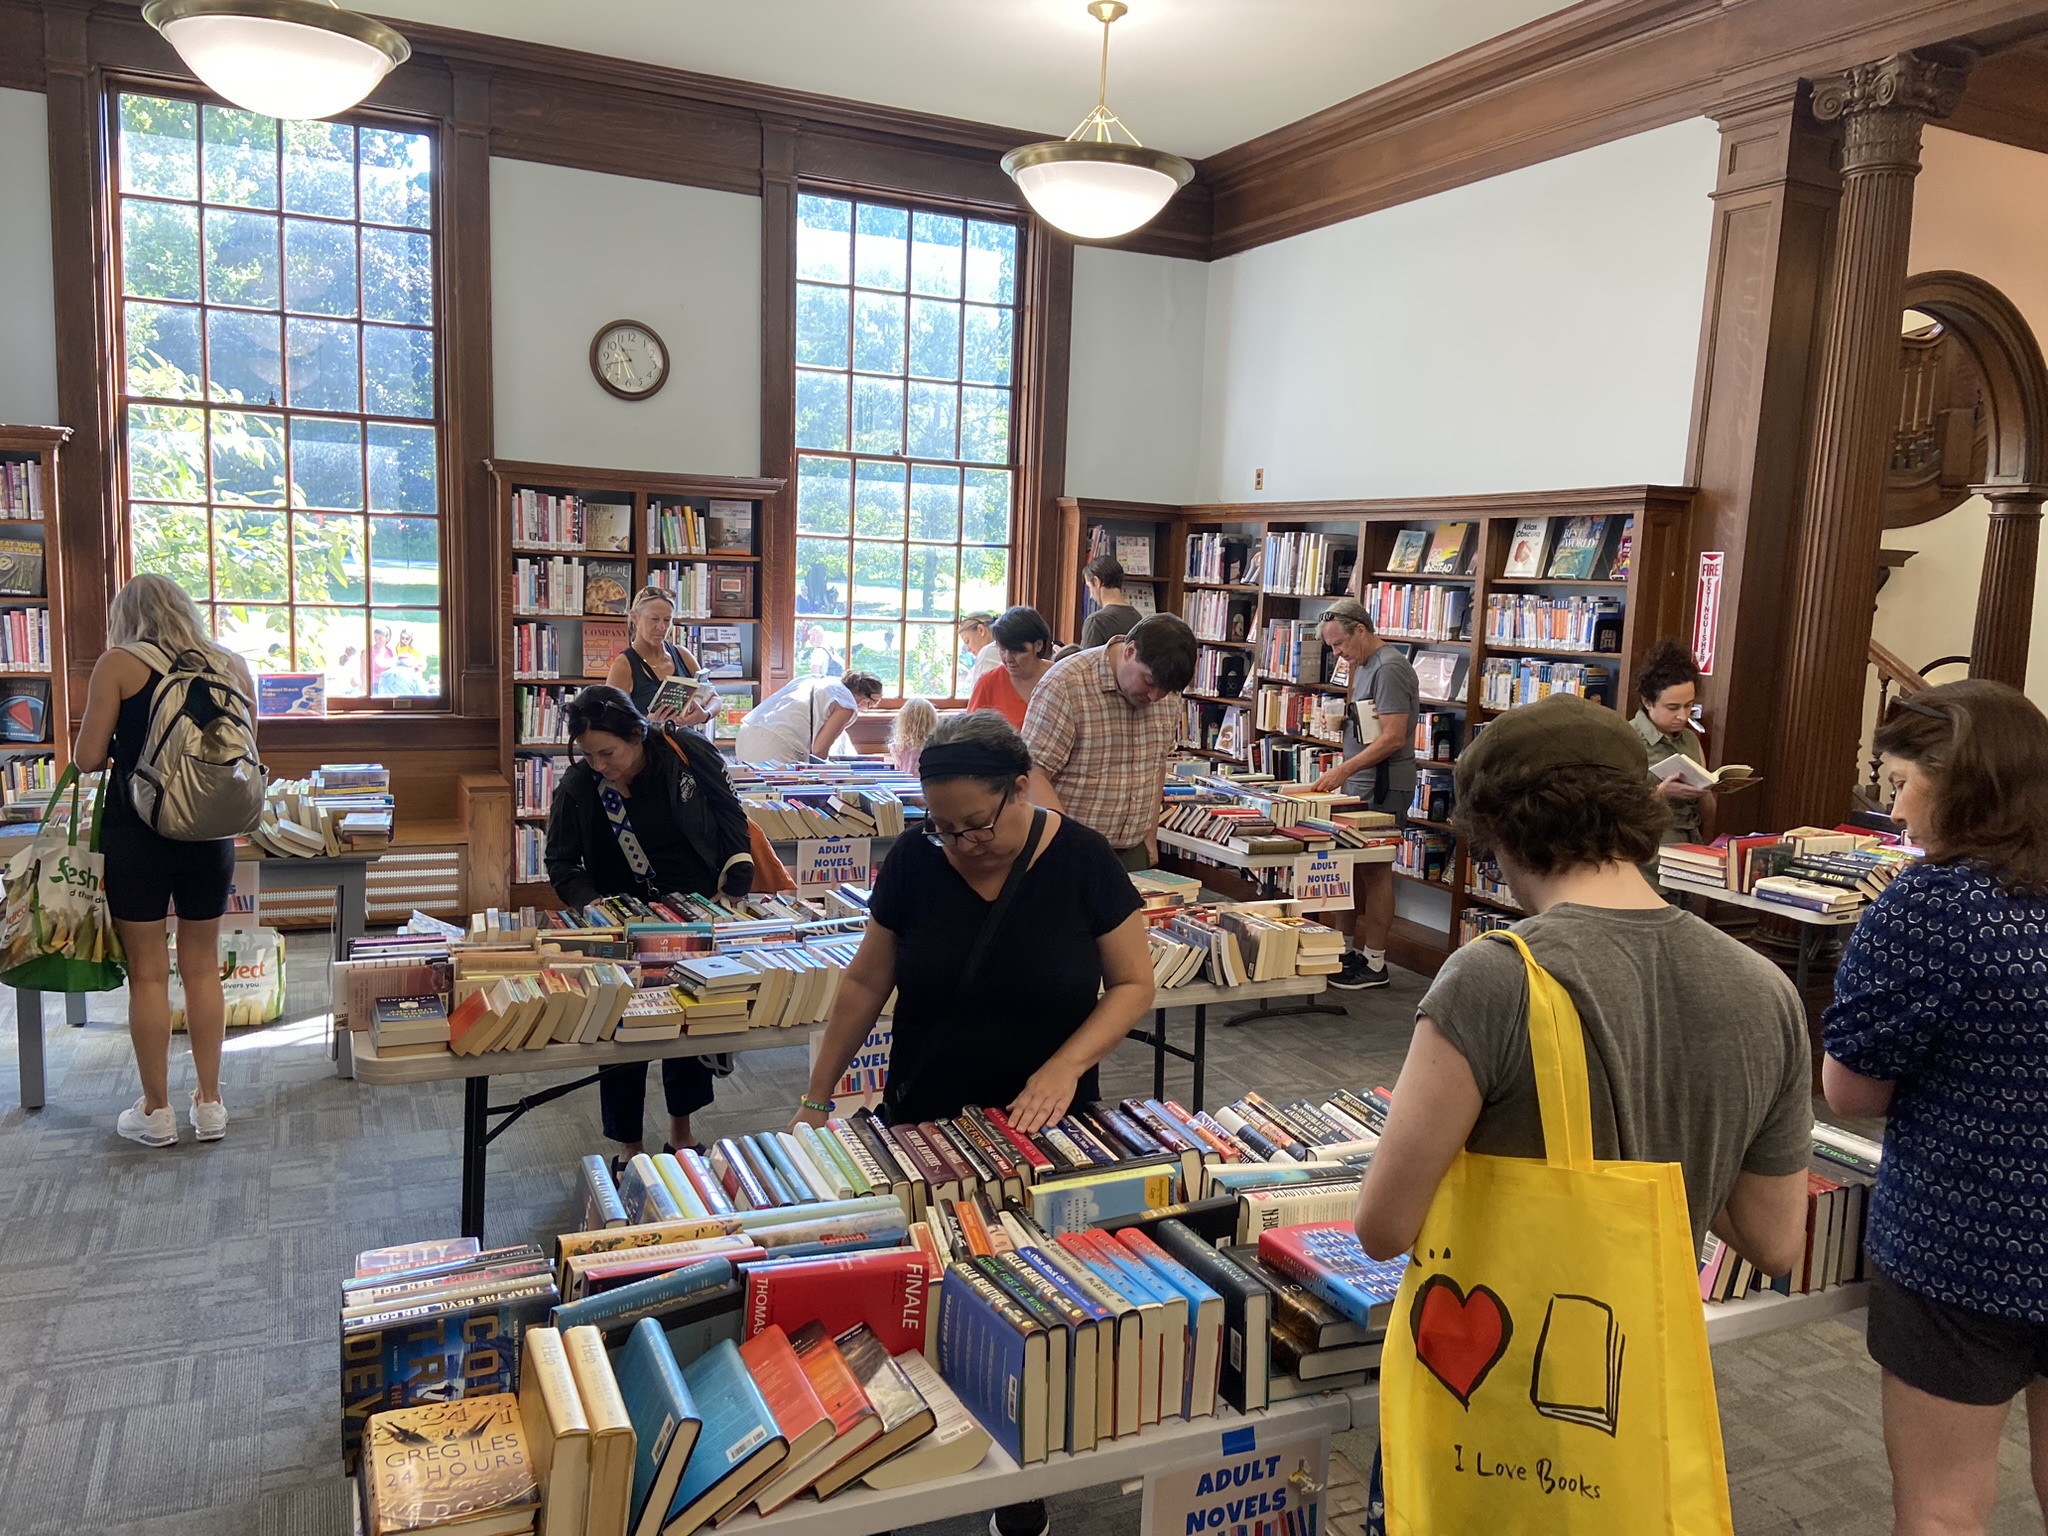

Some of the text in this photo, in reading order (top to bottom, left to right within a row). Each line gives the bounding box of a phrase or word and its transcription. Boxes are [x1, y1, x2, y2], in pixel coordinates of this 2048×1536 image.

[617, 334, 624, 343] 11
[628, 332, 636, 342] 12
[607, 341, 617, 350] 10
[603, 351, 610, 360] 9
[649, 349, 655, 358] 2
[605, 363, 612, 372] 8
[652, 360, 657, 369] 3
[647, 371, 652, 379] 4
[625, 379, 631, 388] 6
[638, 378, 643, 386] 5
[1522, 523, 1538, 531] Atlas
[1516, 530, 1541, 538] Obscura
[17, 541, 40, 549] YOUR
[599, 565, 628, 577] ART PIE
[1702, 563, 1720, 577] FIRE
[1699, 578, 1714, 663] EXTINGUISHER
[584, 628, 627, 637] COMPANY
[818, 845, 851, 855] ADULT
[814, 856, 854, 868] NOVELS
[1310, 861, 1338, 871] ADULT
[1308, 873, 1340, 883] NOVELS
[1821, 873, 1844, 882] AKIN
[627, 1000, 678, 1008] ASTORAL
[623, 1007, 681, 1017] PHILIP ROTH
[862, 1032, 893, 1048] ULT
[849, 1052, 888, 1070] OVEL
[1304, 1103, 1322, 1120] RICHARD
[1351, 1100, 1370, 1113] CLINTON
[1288, 1109, 1307, 1127] ADDIE
[1297, 1108, 1320, 1128] INVISIBLE
[1318, 1122, 1333, 1135] LIFE
[1200, 1115, 1221, 1137] Silva
[959, 1117, 976, 1133] VINCE
[972, 1130, 991, 1148] FLYNN
[990, 1150, 1001, 1161] LAST
[592, 1169, 614, 1210] HAMILTON
[1149, 1187, 1157, 1199] Copy
[1272, 1186, 1320, 1199] BEAUTIFUL
[1303, 1227, 1340, 1236] HAVE
[1309, 1236, 1350, 1244] SOME
[1323, 1254, 1353, 1264] FOR
[380, 1263, 411, 1273] HENRY
[498, 1264, 537, 1277] FIRST
[684, 1263, 705, 1274] KEANE
[1031, 1252, 1044, 1266] Other
[1043, 1261, 1057, 1277] Black
[1056, 1272, 1069, 1285] Girl
[1067, 1260, 1085, 1274] STORE
[1213, 1258, 1244, 1283] HANNAH
[1221, 1257, 1250, 1279] KRISTIN
[442, 1269, 493, 1285] STRIKE
[1005, 1251, 1058, 1296] HELLO BEAUTIFUL
[373, 1284, 402, 1296] COE
[407, 1279, 434, 1291] BEN
[956, 1262, 1010, 1306] HELLO BEAUTIFUL
[902, 1263, 923, 1330] FINALE
[1000, 1272, 1017, 1289] FIRST
[1016, 1286, 1030, 1298] LIE
[1027, 1295, 1046, 1312] WINS
[363, 1286, 544, 1324] TRAP THE DEVIL BEN COES
[542, 1345, 559, 1366] Help
[582, 1344, 601, 1365] Help
[386, 1433, 519, 1468] GREG ILES
[386, 1451, 525, 1489] 24 HOURS
[1196, 1455, 1281, 1497] ADULT
[1455, 1445, 1602, 1500] I Love Books
[1186, 1487, 1287, 1536] NOVELS
